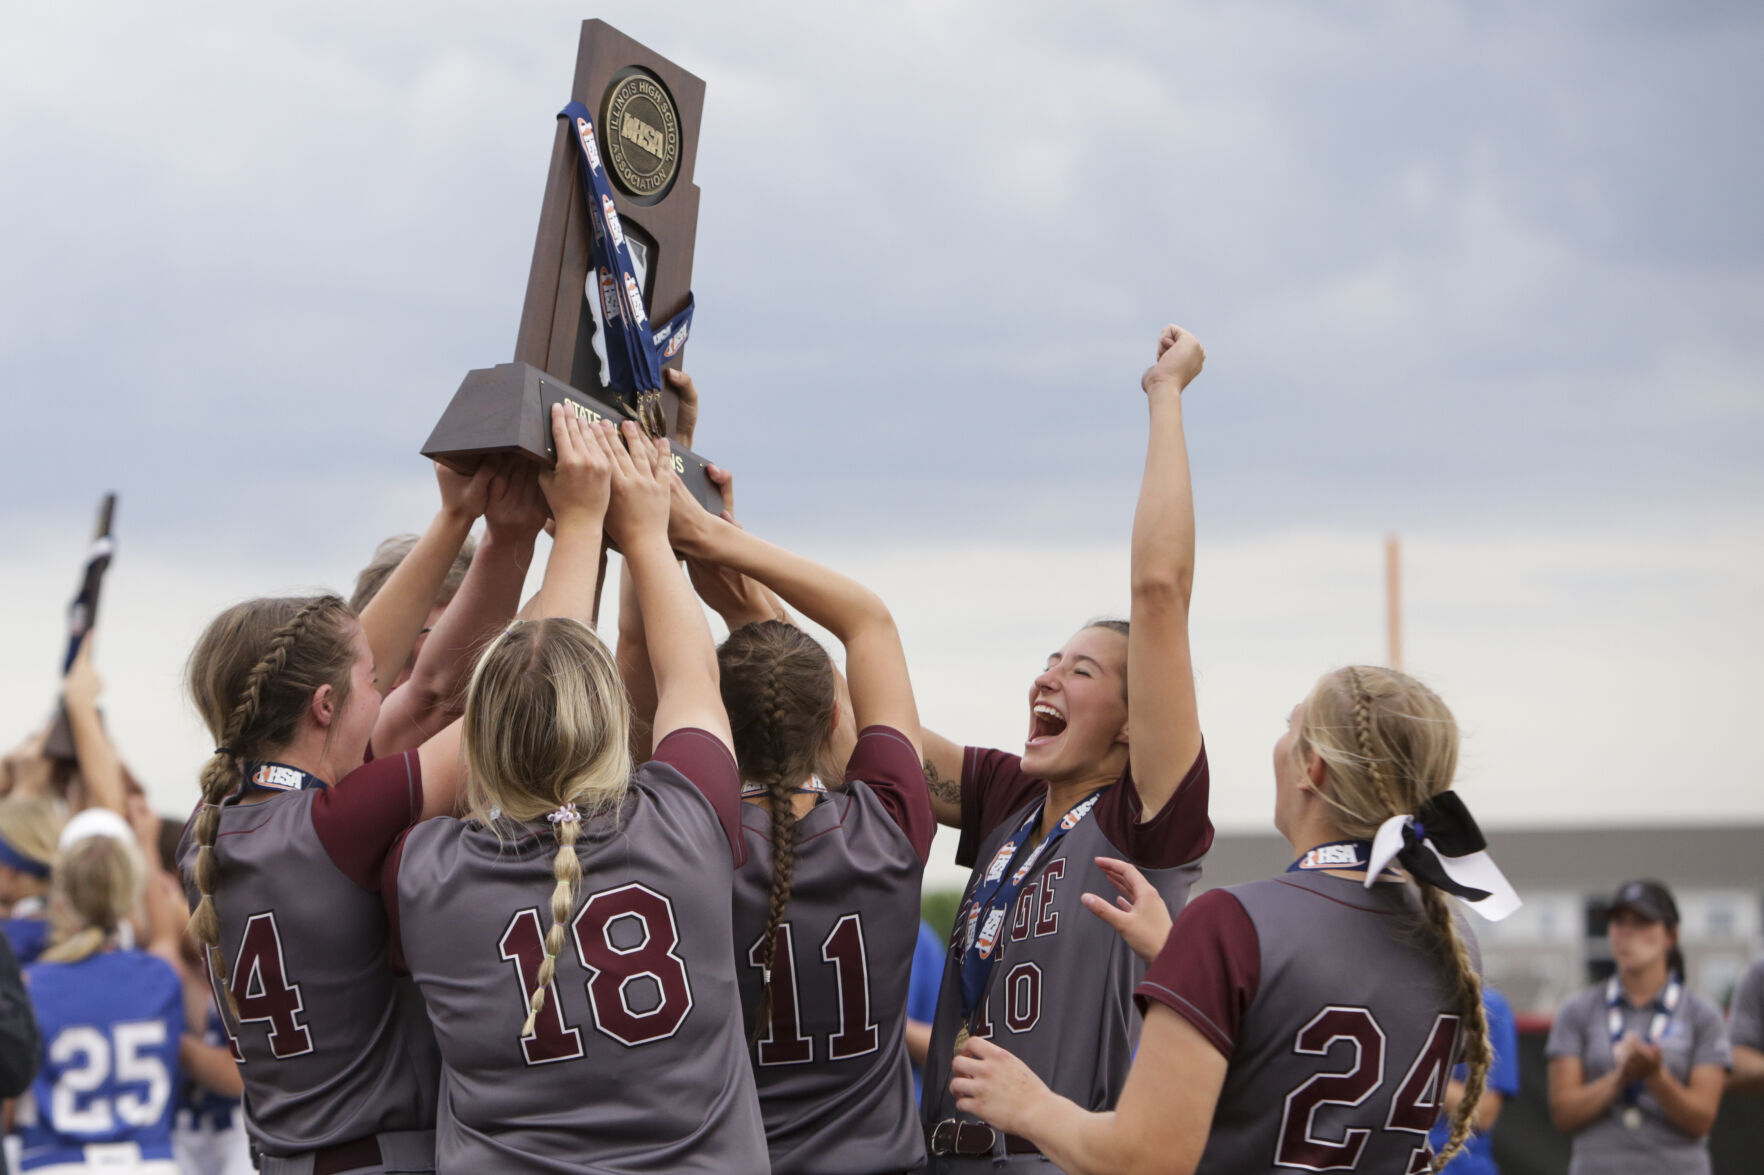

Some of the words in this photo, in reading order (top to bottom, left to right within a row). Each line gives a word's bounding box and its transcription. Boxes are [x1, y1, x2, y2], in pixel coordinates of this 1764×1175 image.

[610, 82, 637, 131] ILLINOIS
[639, 82, 662, 103] HIGH
[660, 102, 676, 161] SCHOOL
[612, 143, 667, 189] ASSOCIATION
[498, 881, 694, 1067] 18
[748, 913, 879, 1066] 11
[50, 1020, 171, 1133] 25
[1274, 1006, 1460, 1175] 24
